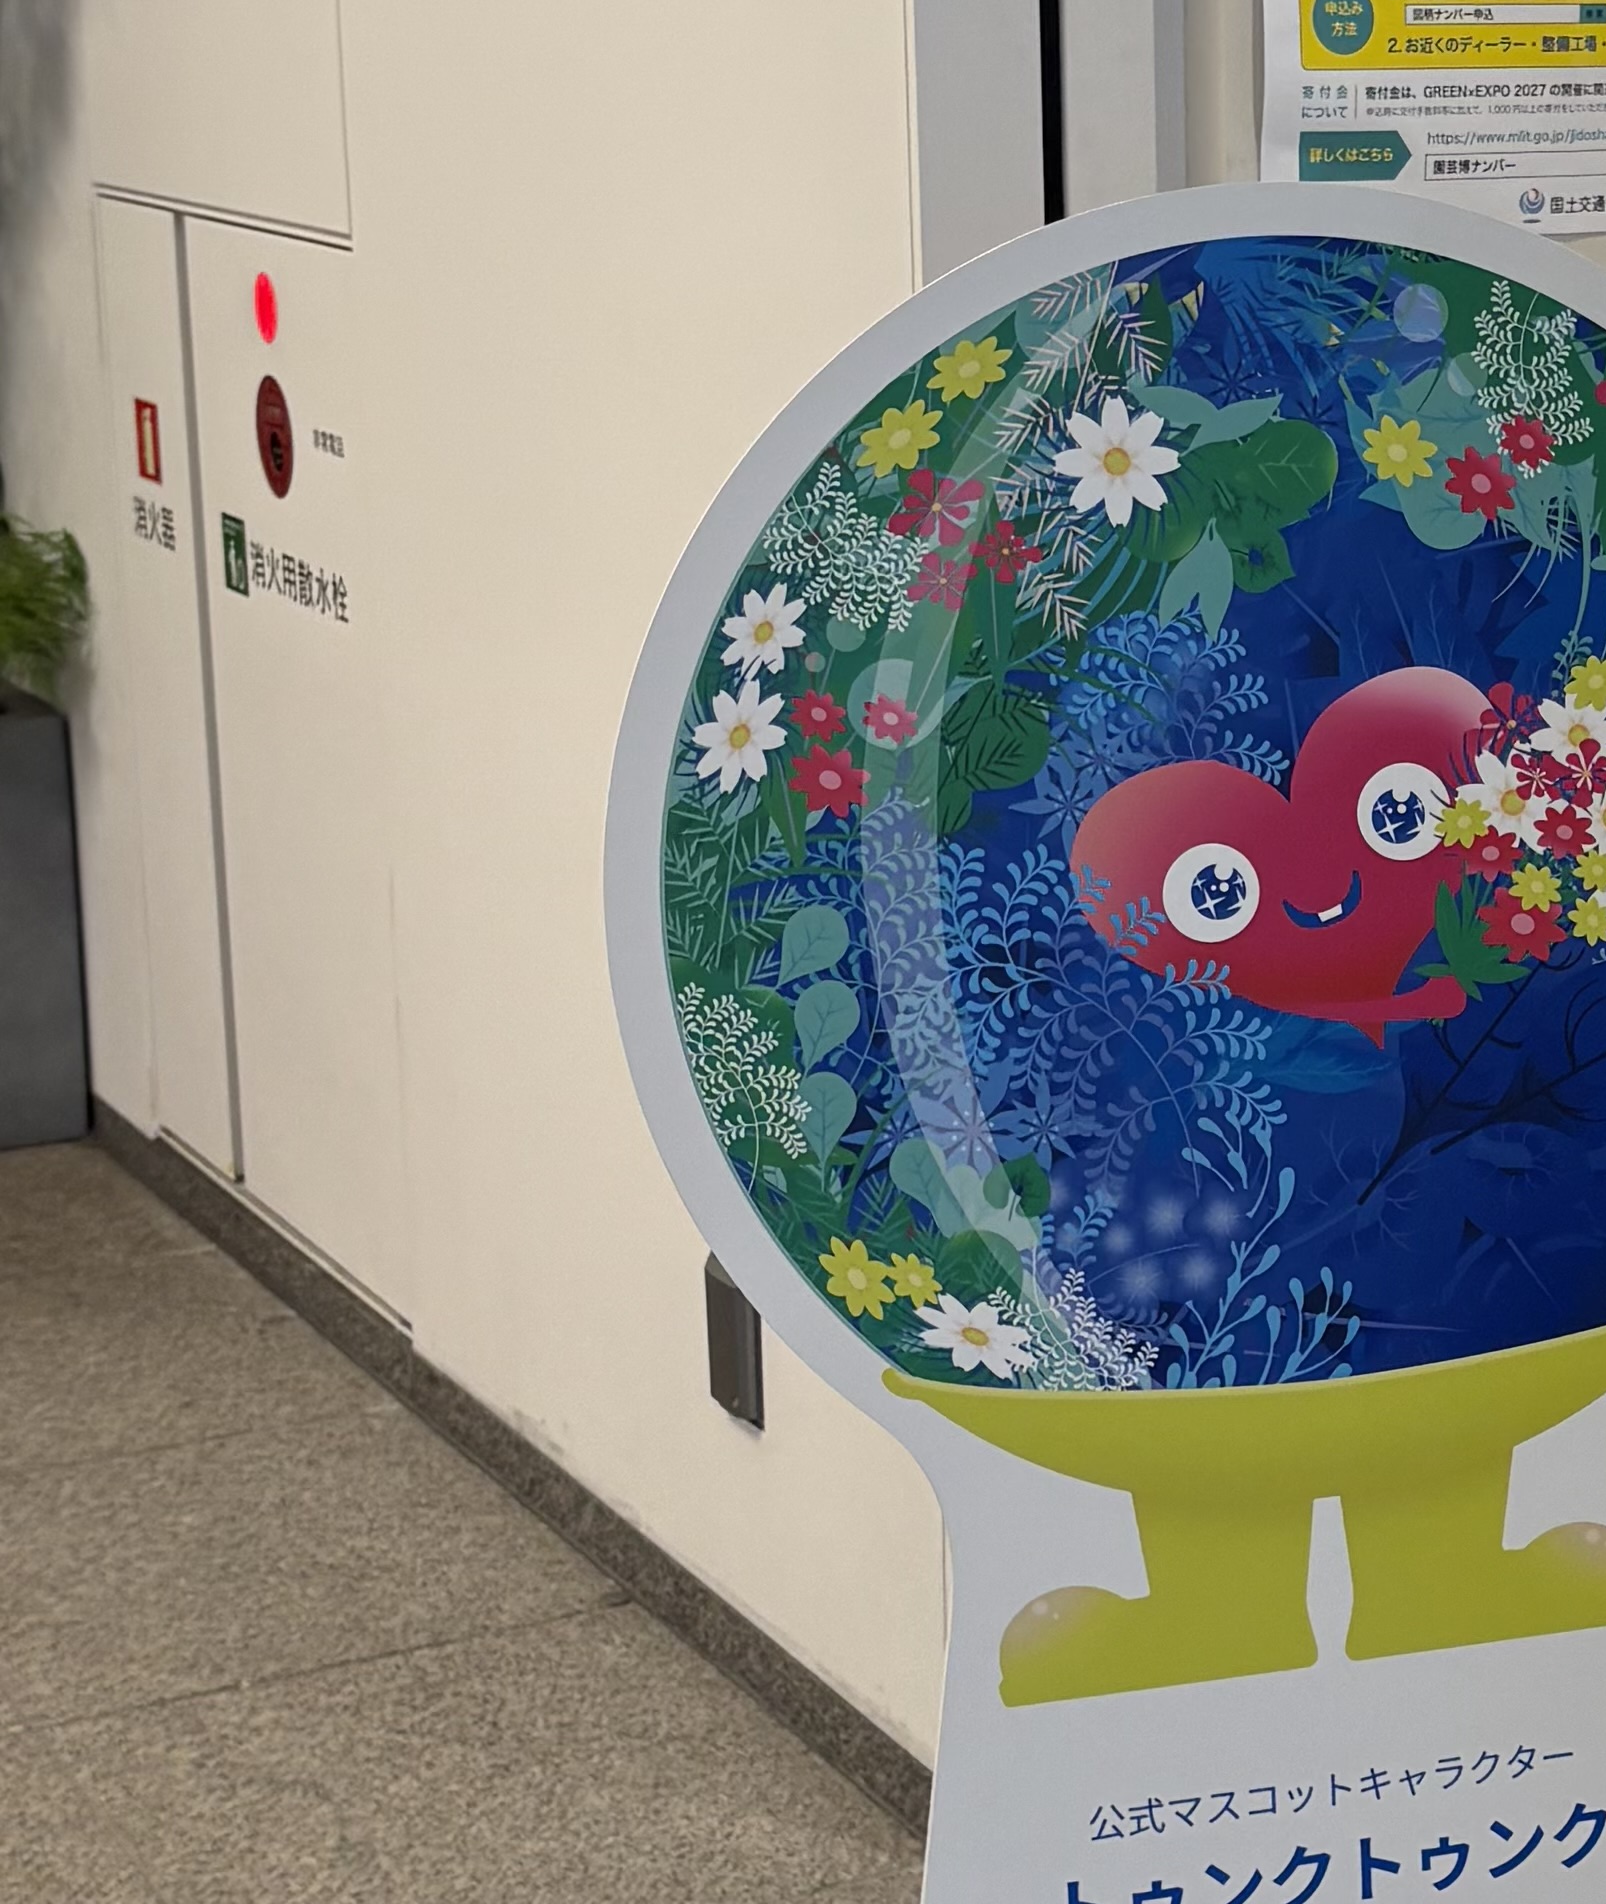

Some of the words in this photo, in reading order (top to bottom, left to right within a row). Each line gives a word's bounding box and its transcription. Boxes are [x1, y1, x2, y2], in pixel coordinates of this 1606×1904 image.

[1325, 0, 1363, 16] 申込み
[1331, 21, 1358, 37] 方法
[1301, 106, 1348, 119] について
[1309, 147, 1394, 163] 詳しくはこちら
[1433, 158, 1516, 175] 園芸博ナンバー
[132, 494, 176, 552] 消火器
[250, 540, 349, 624] 消火用散水栓
[1089, 1744, 1575, 1843] 公式マスコットキャラクター
